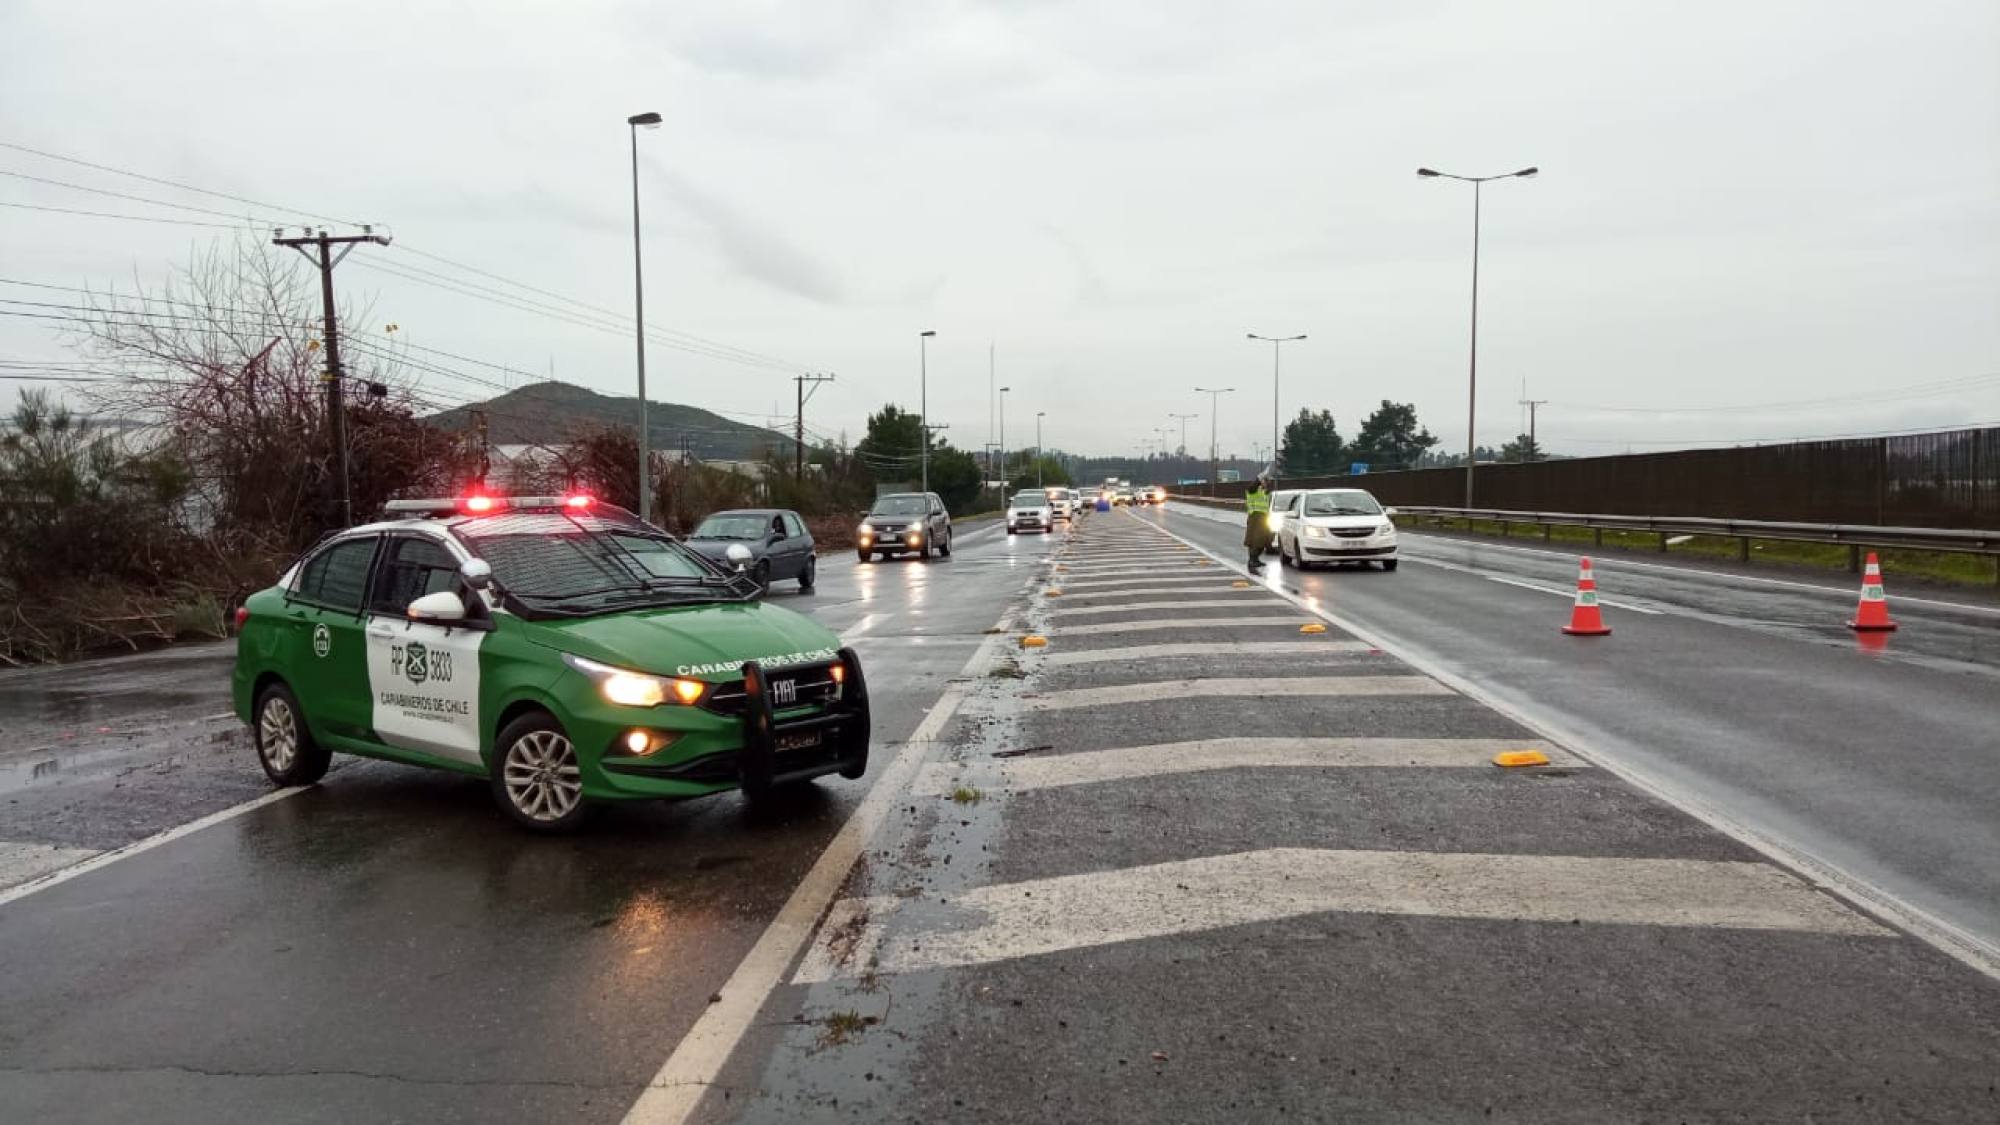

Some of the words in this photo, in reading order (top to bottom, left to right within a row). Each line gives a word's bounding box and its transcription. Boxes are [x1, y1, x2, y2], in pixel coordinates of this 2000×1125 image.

[391, 645, 404, 676] RP
[430, 650, 452, 682] 5833
[380, 691, 432, 711] CARABINEROS
[432, 697, 445, 712] DE
[446, 699, 469, 715] CHILE
[773, 679, 797, 704] FIAT
